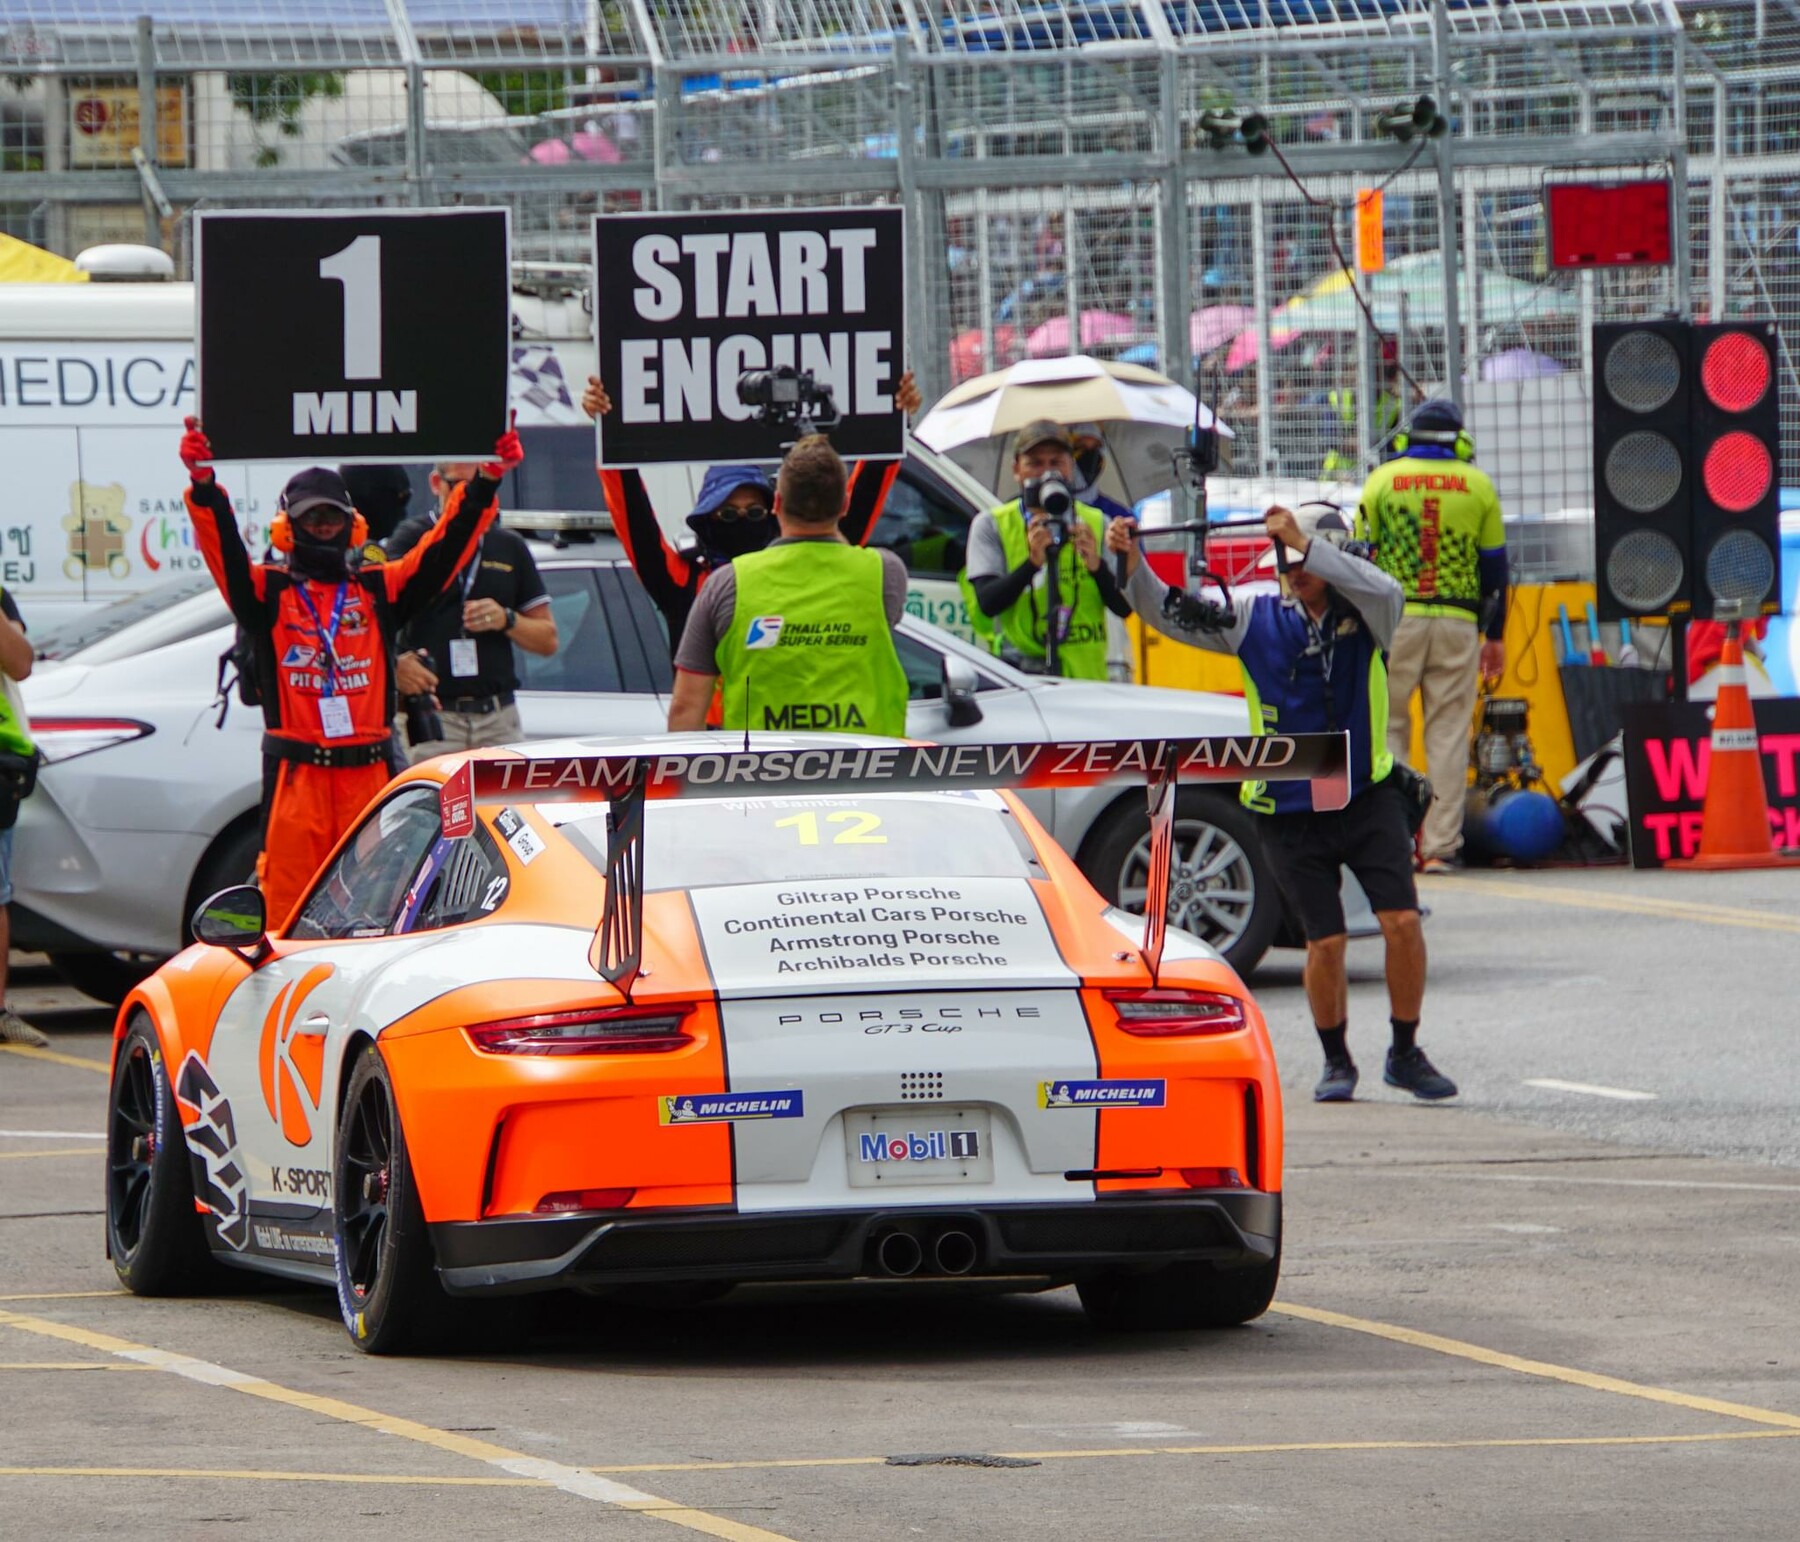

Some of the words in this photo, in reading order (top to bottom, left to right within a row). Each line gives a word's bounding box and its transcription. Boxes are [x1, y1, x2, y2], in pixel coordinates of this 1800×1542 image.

[632, 228, 877, 322] START
[319, 235, 382, 380] 1
[293, 390, 418, 435] MIN
[778, 635, 823, 646] SUPER
[825, 634, 868, 646] SERIES
[784, 623, 851, 634] THAILAND
[290, 673, 311, 687] PIT
[764, 703, 867, 731] MEDIA
[494, 757, 638, 790] TEAM
[652, 748, 900, 785] PORSCHE
[909, 744, 1042, 778] NEW
[1050, 736, 1296, 773] ZEALAND
[1644, 733, 1800, 802] WT
[722, 800, 765, 811] Will
[772, 798, 860, 810] Bamber
[774, 811, 888, 845] 12
[480, 875, 508, 911] 12
[777, 891, 859, 906] Giltrap
[864, 887, 962, 900] Porsche
[724, 908, 867, 935] Continental
[871, 907, 927, 922] Cars
[931, 907, 1028, 925] Porsche
[770, 932, 898, 953] Armstrong
[902, 929, 1001, 946] Porsche
[778, 952, 905, 974] Archibalds
[910, 951, 1008, 967] Porsche
[779, 1007, 1041, 1025] PORSCHE
[921, 1023, 963, 1034] Cup
[1074, 1087, 1156, 1100] MICHELIN
[700, 1098, 792, 1115] MICHELIN
[860, 1131, 947, 1162] Mobil
[954, 1132, 974, 1159] 1
